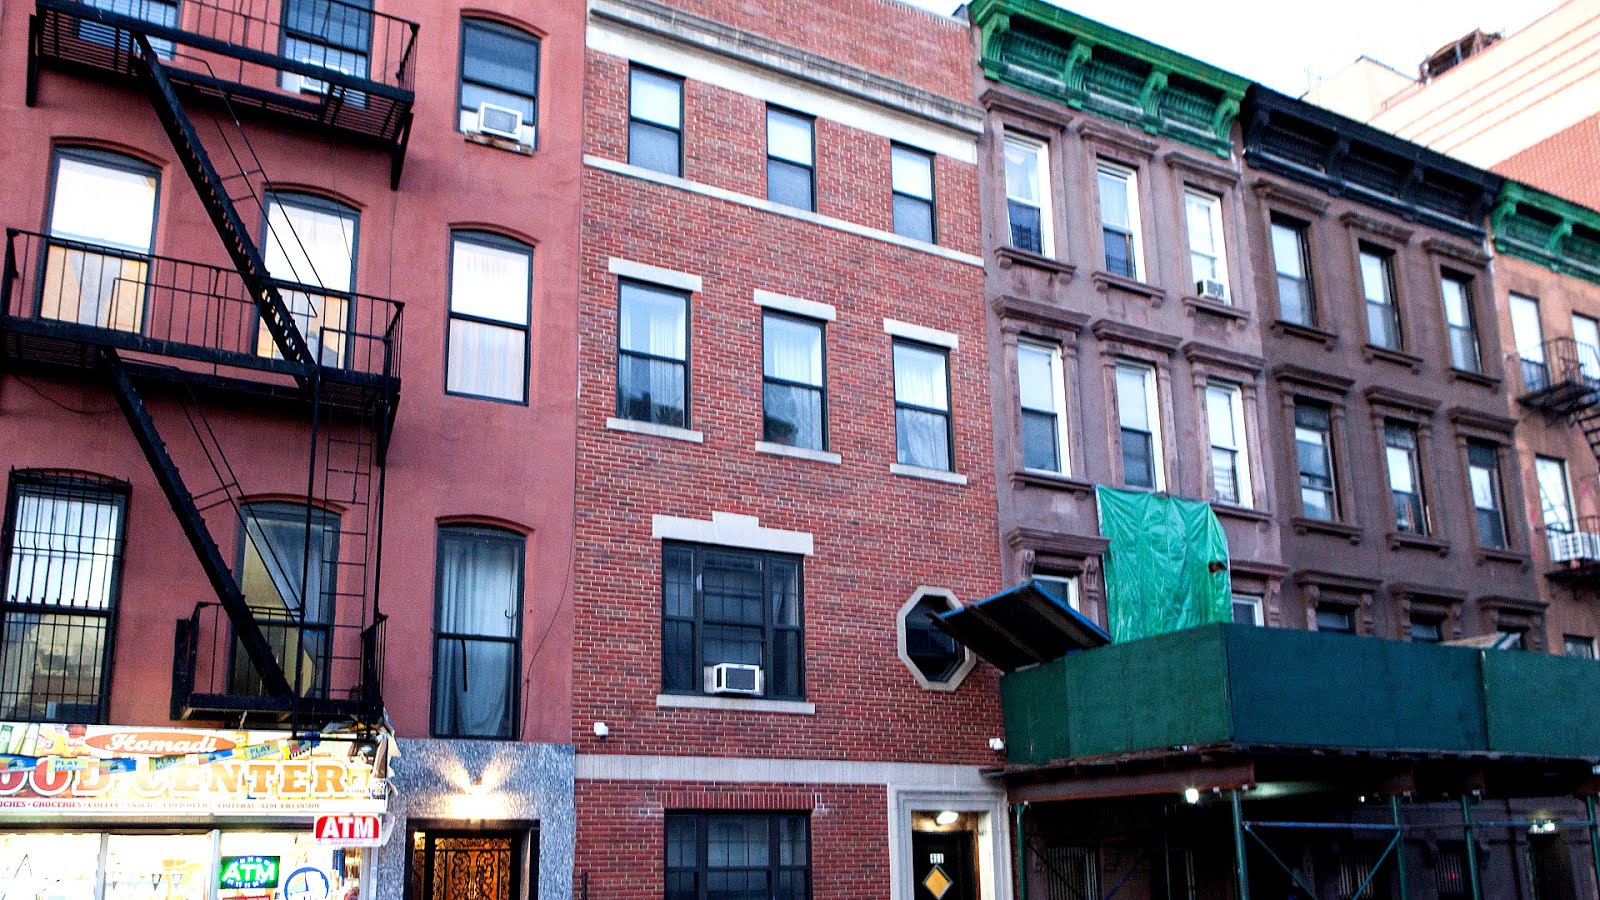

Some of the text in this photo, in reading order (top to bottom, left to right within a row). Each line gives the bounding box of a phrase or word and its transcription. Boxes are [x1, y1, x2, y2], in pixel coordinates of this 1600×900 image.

[249, 744, 271, 755] PLAY
[155, 756, 177, 765] PLAY
[134, 762, 346, 794] CENTER
[32, 800, 81, 808] GROCERIES
[321, 816, 374, 838] ATM
[222, 862, 275, 881] ATM
